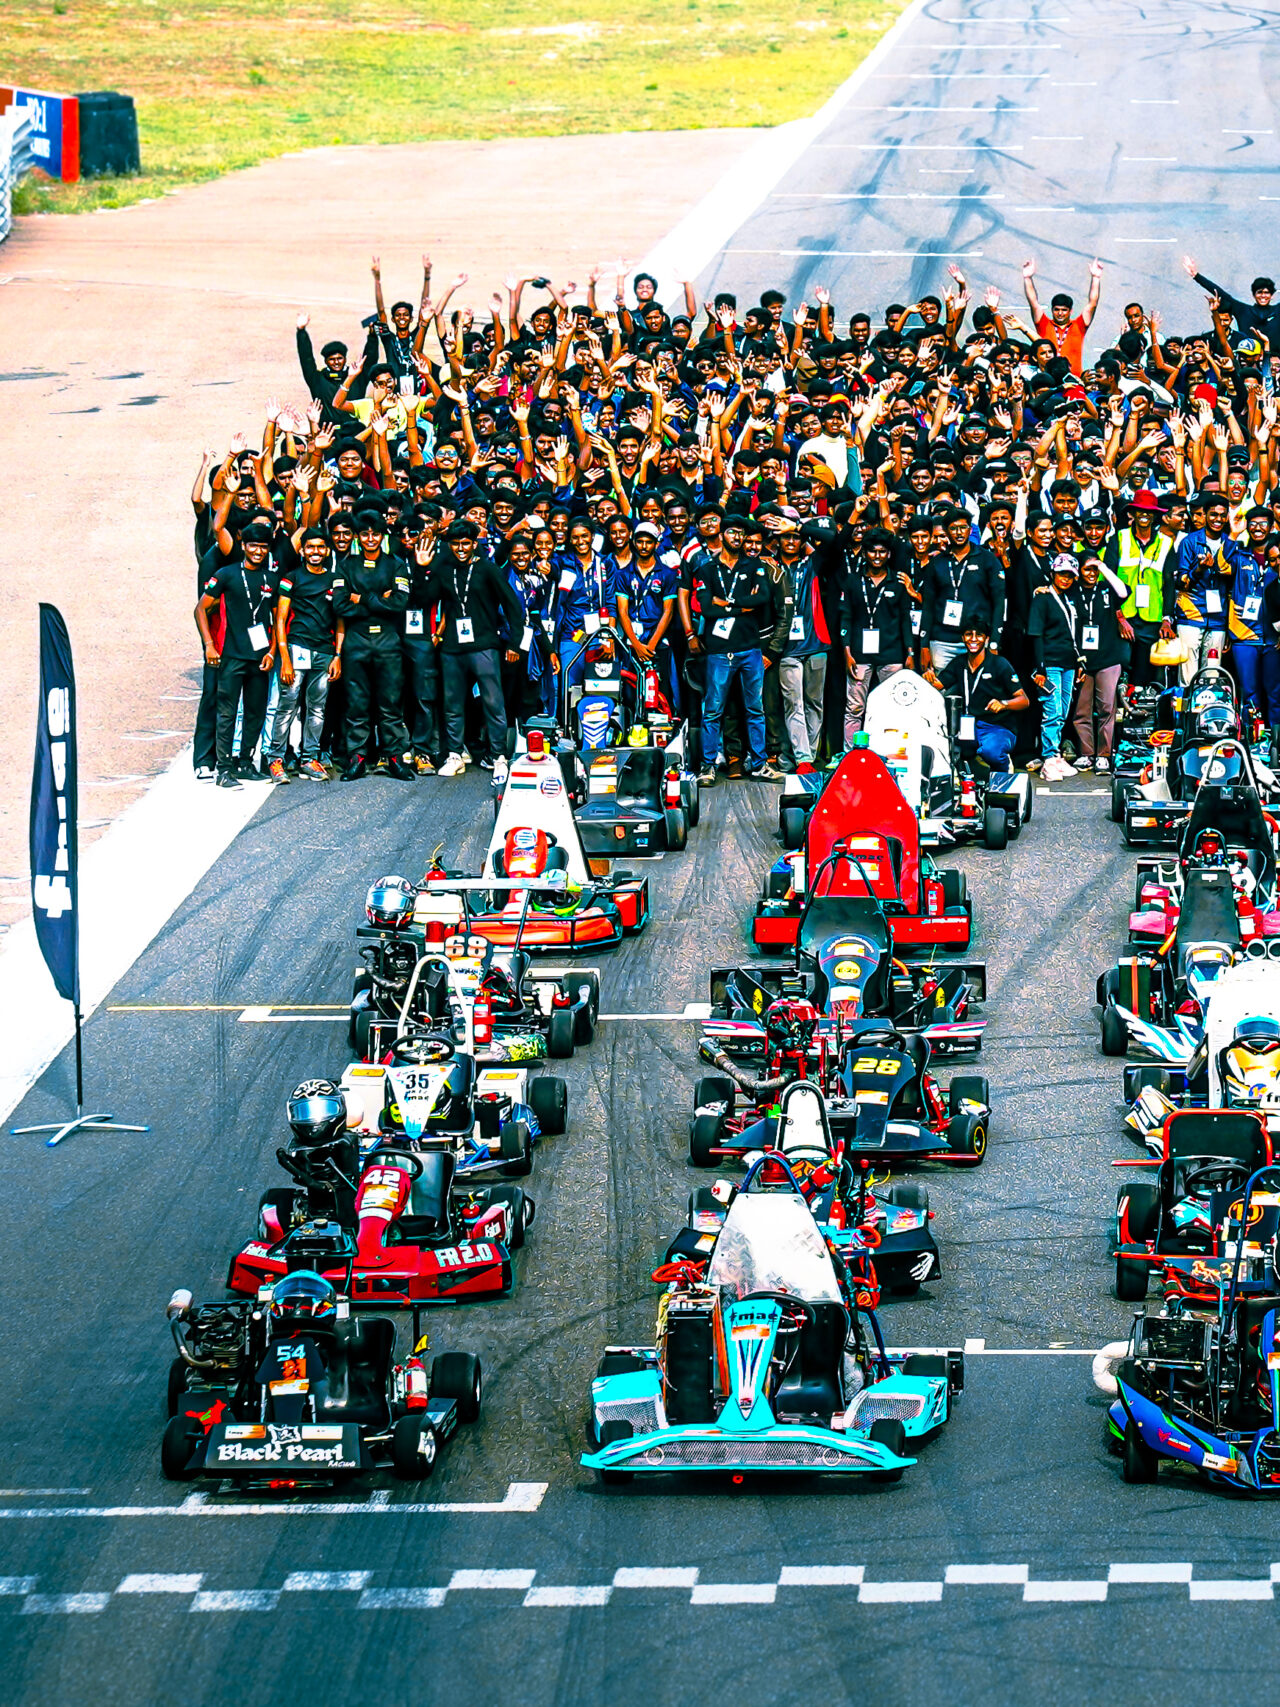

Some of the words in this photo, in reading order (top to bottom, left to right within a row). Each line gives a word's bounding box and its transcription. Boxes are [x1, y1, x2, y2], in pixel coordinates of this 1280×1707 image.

[853, 1057, 901, 1076] 28
[405, 1073, 430, 1090] 35
[363, 1169, 401, 1188] 42
[434, 1247, 462, 1267] FR
[459, 1243, 493, 1264] 2.0
[277, 1344, 306, 1362] 54
[217, 1442, 282, 1461] Black
[285, 1443, 344, 1462] Pearl
